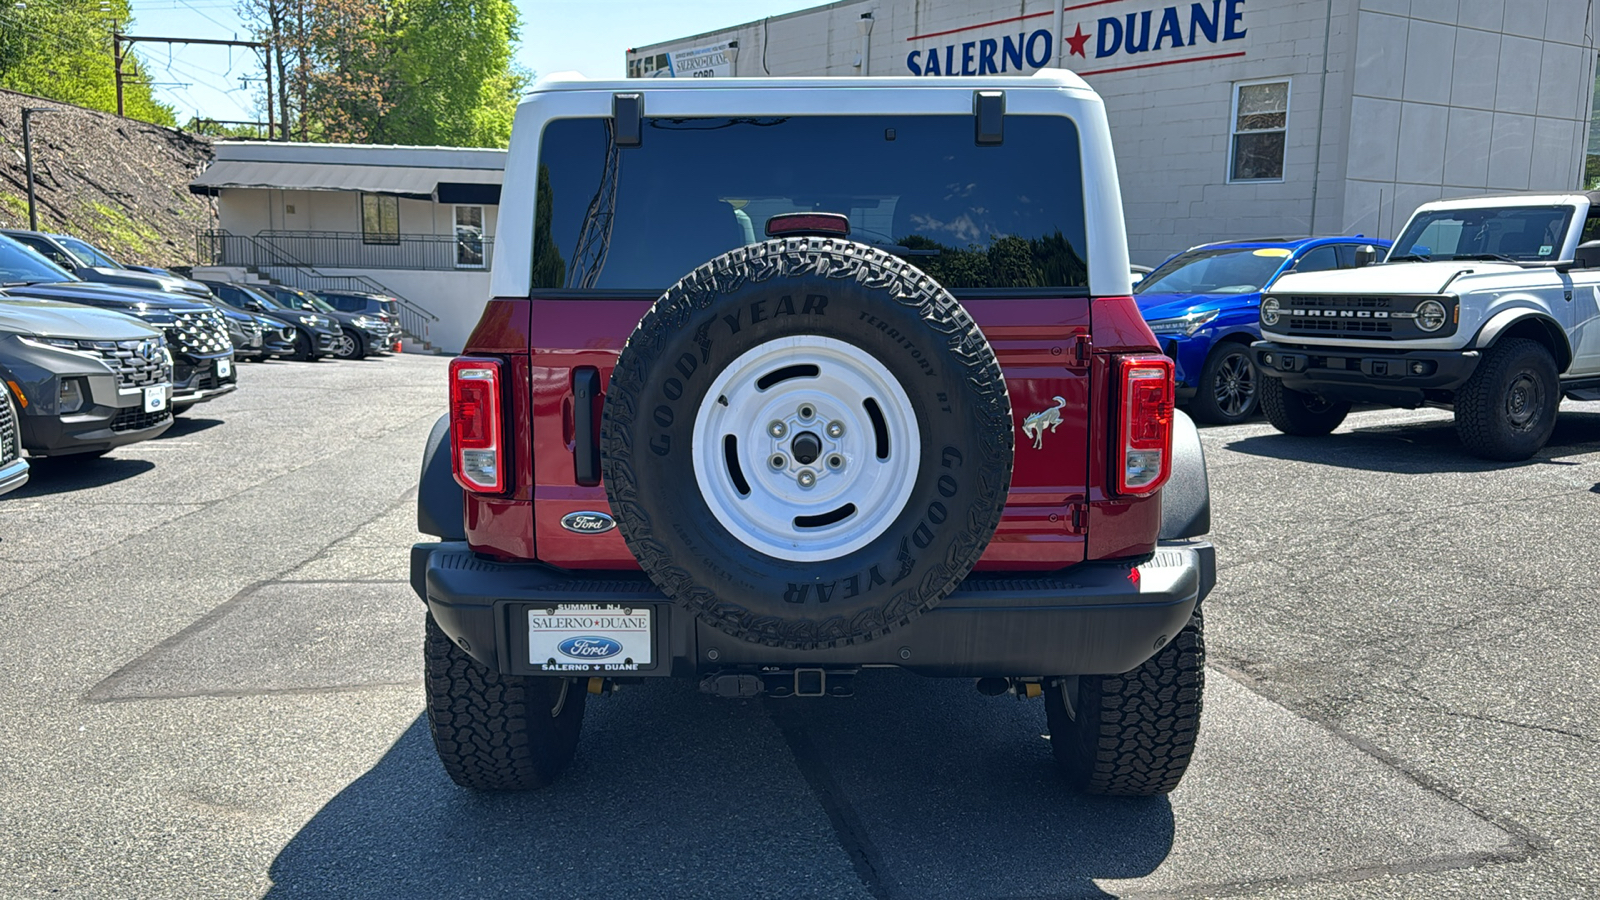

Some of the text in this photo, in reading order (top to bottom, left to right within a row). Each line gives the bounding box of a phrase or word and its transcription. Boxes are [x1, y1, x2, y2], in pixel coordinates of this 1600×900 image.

[906, 0, 1248, 77] SALERNO DUANE
[1293, 309, 1389, 318] BRONCO
[859, 311, 937, 377] TERRITORY
[572, 516, 603, 530] Ford
[532, 617, 647, 629] SALERNO DUANE
[570, 639, 609, 656] Ford
